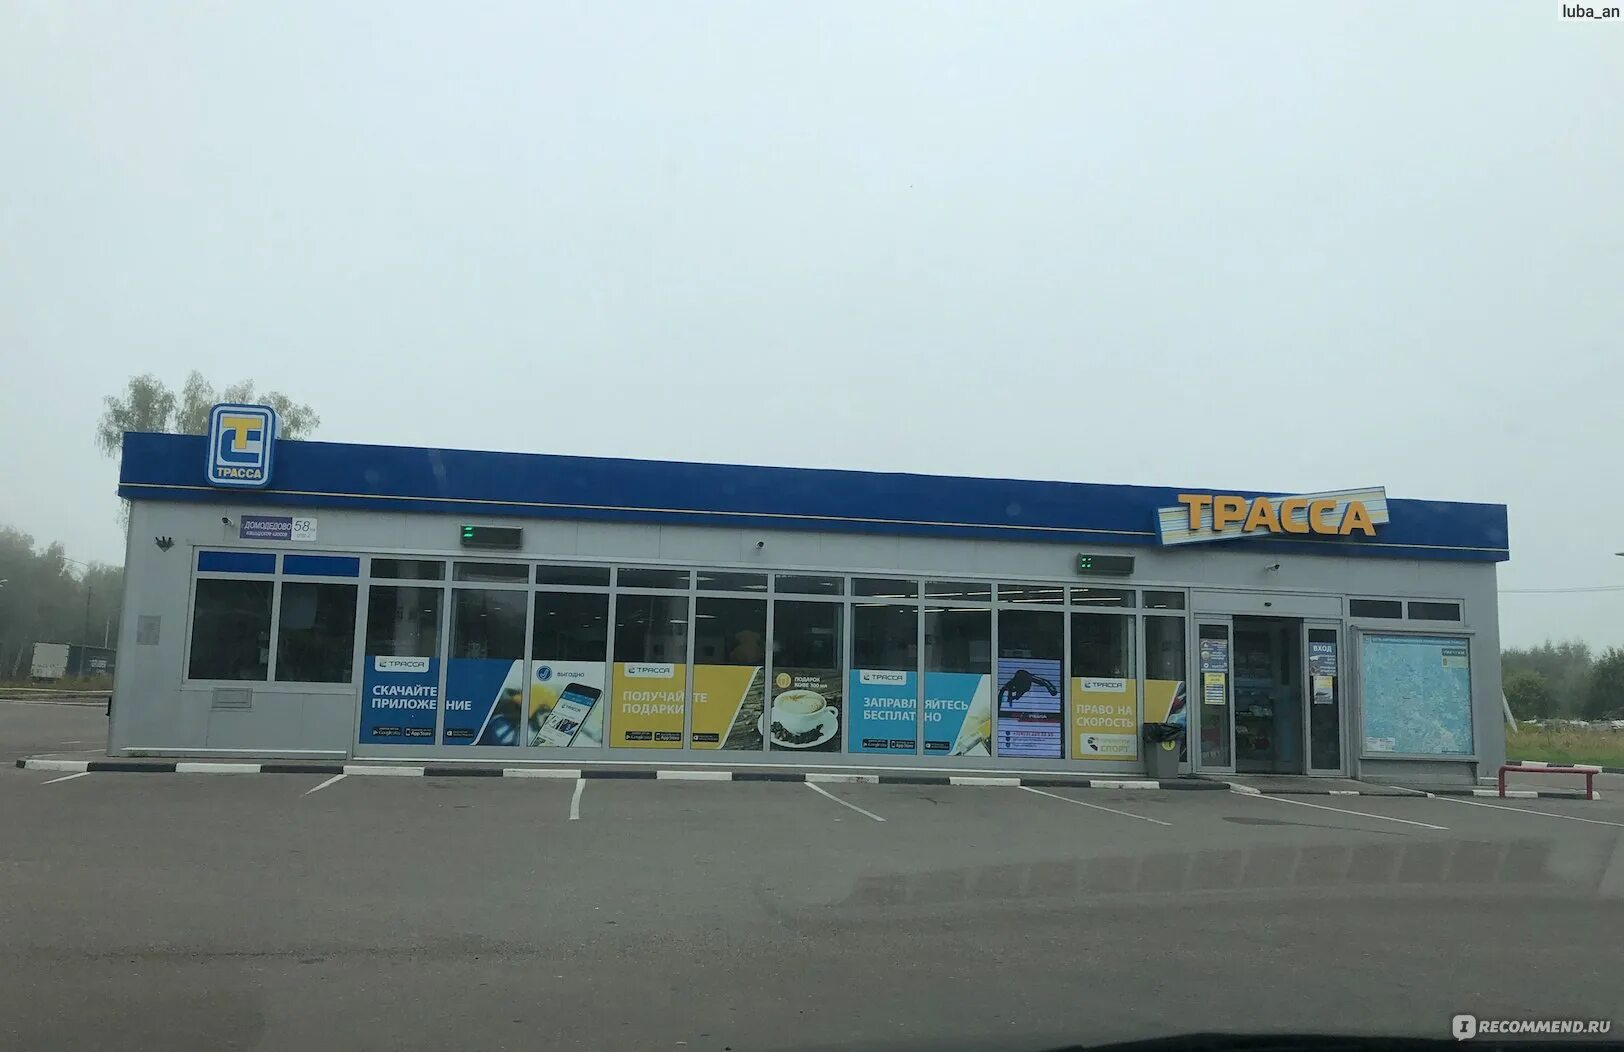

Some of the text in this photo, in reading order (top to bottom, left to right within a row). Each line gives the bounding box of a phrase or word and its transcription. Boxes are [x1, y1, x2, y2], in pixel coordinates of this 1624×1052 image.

[216, 467, 262, 479] ТРАССА
[1178, 494, 1376, 536] ТРАССА
[244, 521, 292, 531] ДОМОДЕДОВО
[372, 684, 438, 697] СКАЧАЙТЕ
[622, 703, 684, 715] ПОДАРКИ
[1076, 704, 1133, 716] ПРАВО НА
[1076, 717, 1134, 728] СКОРОСТЬ
[1100, 745, 1129, 753] СПОРТ
